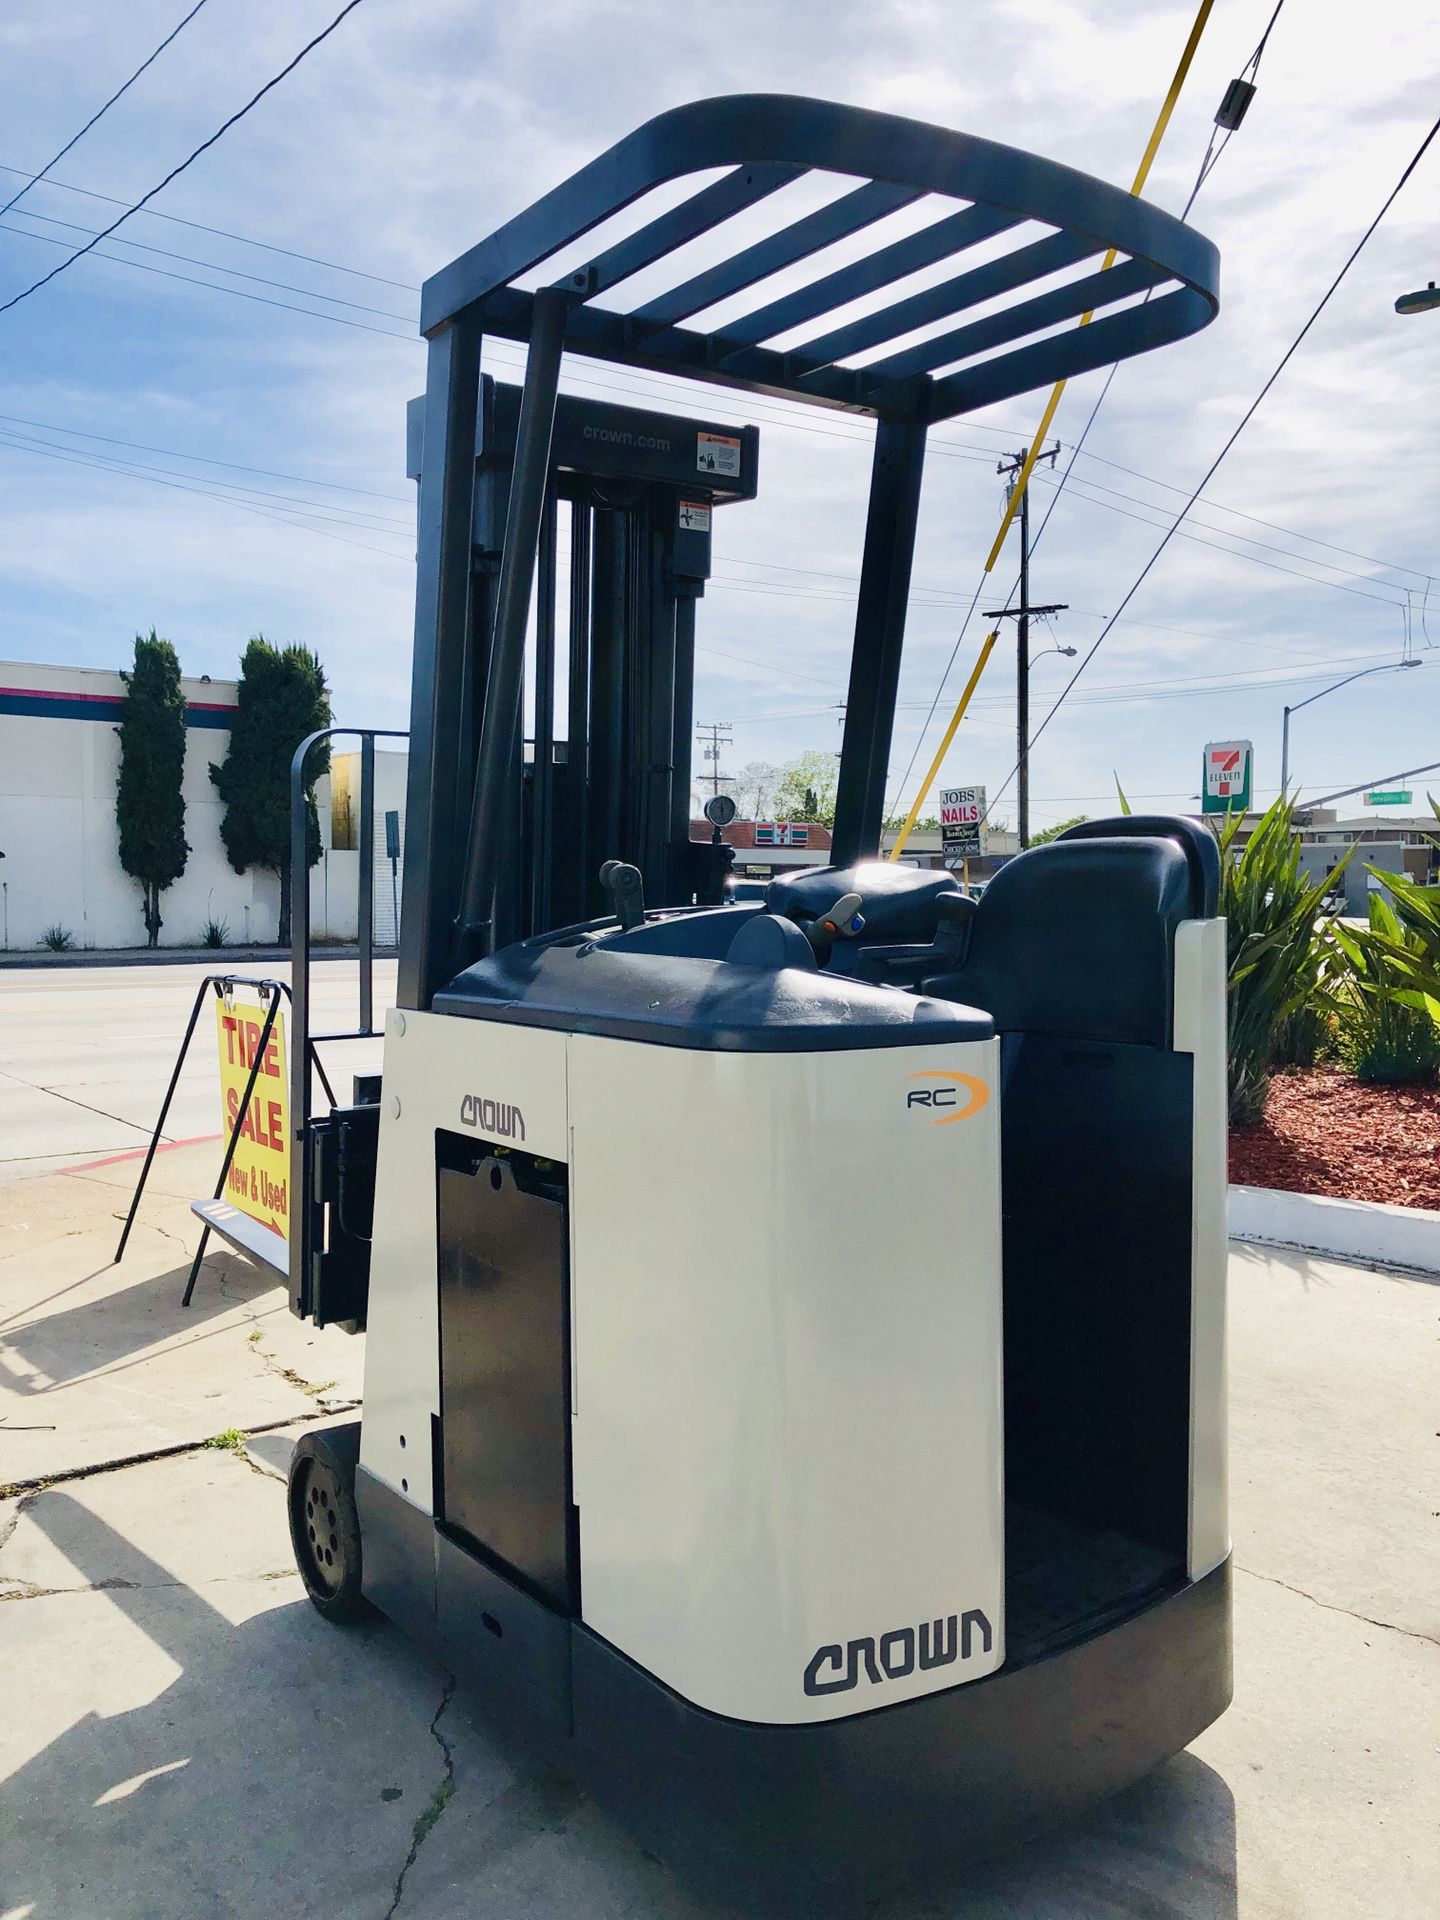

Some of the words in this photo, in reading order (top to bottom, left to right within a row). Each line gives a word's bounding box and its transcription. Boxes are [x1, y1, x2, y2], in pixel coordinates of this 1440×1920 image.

[583, 425, 671, 452] crown.com
[1212, 750, 1239, 795] 7
[942, 806, 977, 823] NAILS
[943, 790, 975, 804] JOBS
[222, 1016, 280, 1078] TIRE
[227, 1087, 284, 1152] SALE
[460, 1094, 526, 1141] CROWN
[907, 1088, 957, 1108] RC
[251, 1165, 259, 1202] &
[260, 1170, 287, 1215] Used
[803, 1608, 992, 1697] CROWN
